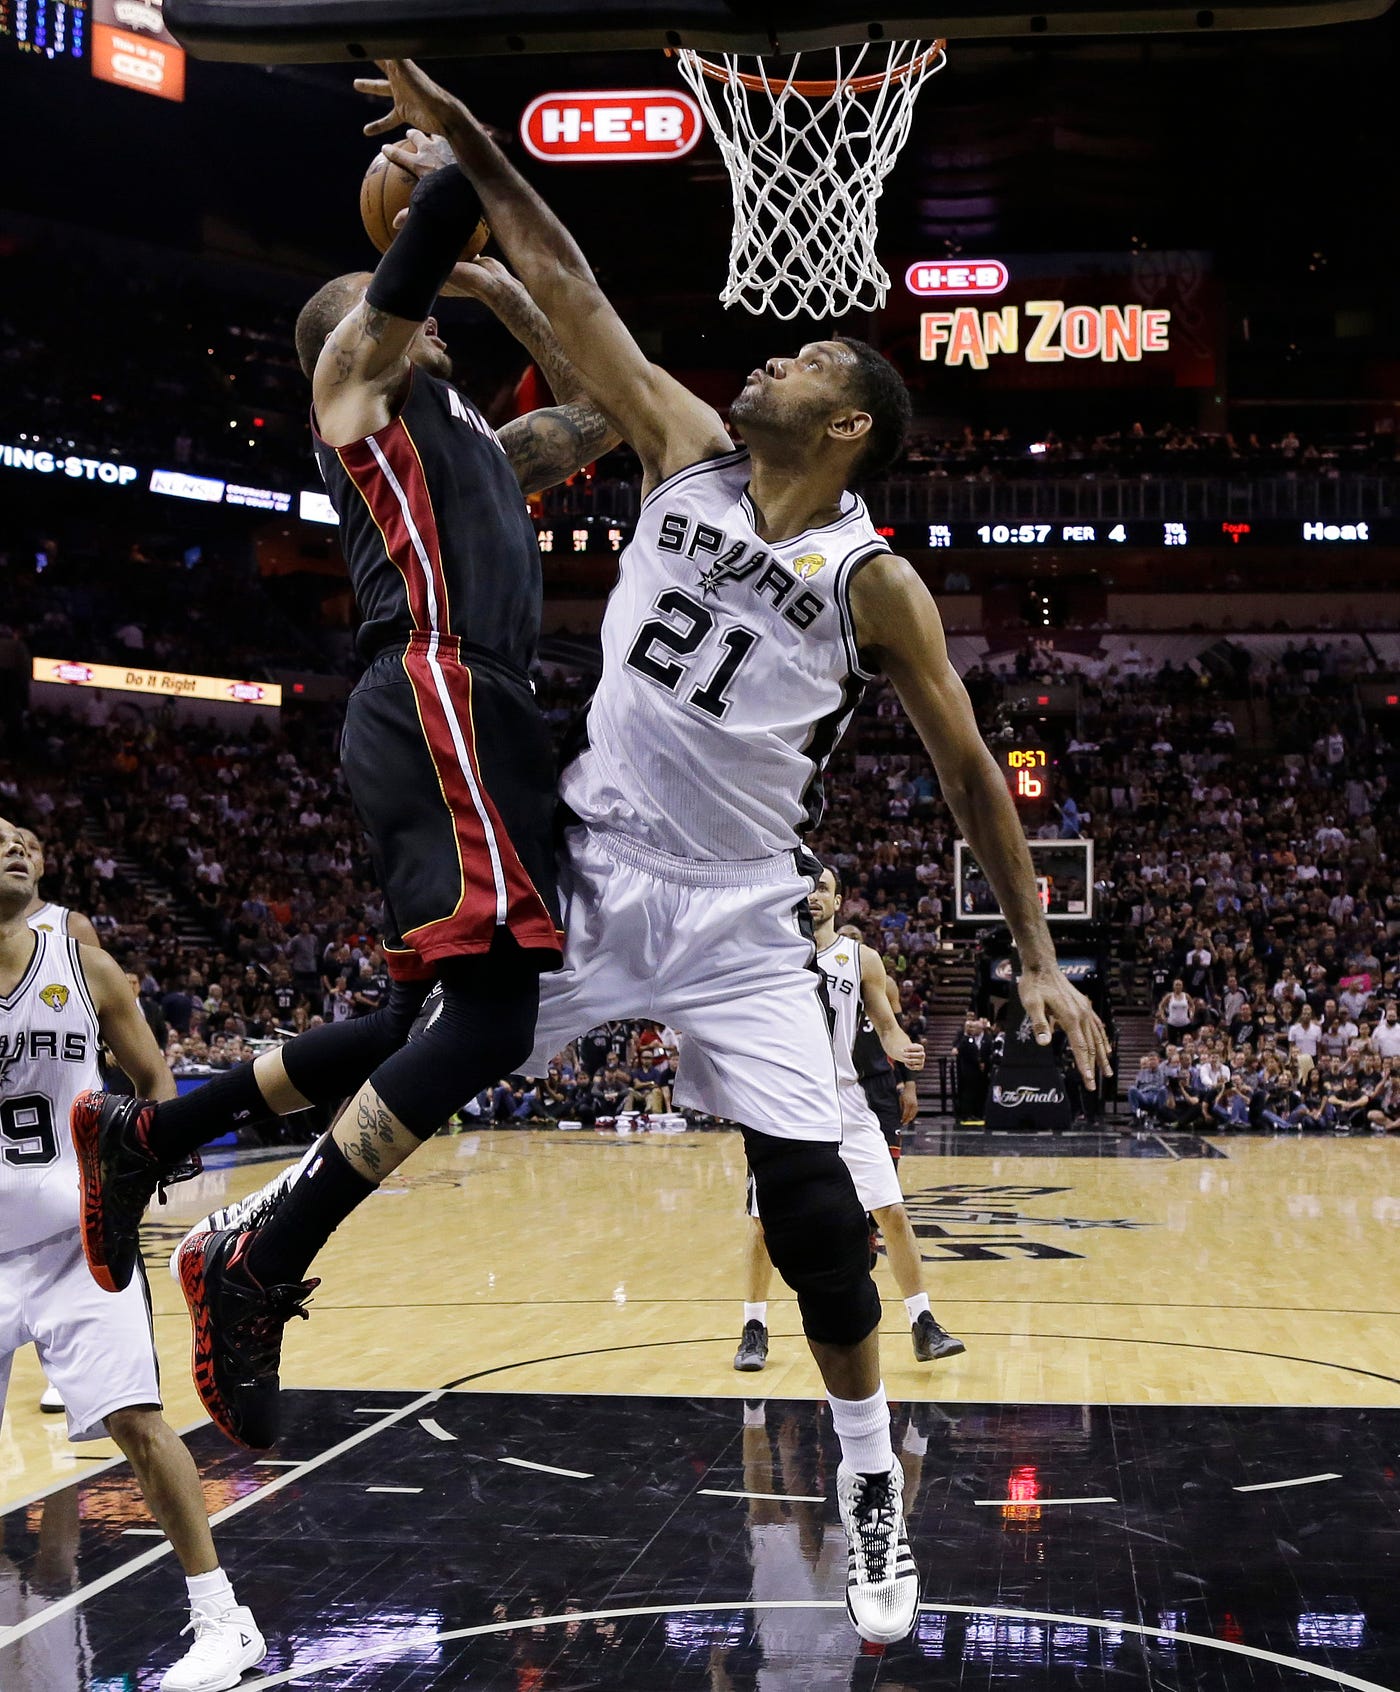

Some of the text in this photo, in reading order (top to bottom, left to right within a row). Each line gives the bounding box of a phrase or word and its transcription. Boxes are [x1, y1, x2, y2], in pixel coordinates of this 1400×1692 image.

[920, 300, 1170, 369] FAN ZONE
[977, 524, 1126, 543] 10:57 PER 4
[1303, 522, 1368, 541] Heat
[657, 512, 826, 631] SPURS
[622, 586, 761, 723] 21
[161, 676, 196, 694] Right
[1008, 750, 1046, 767] 10:57
[1011, 1086, 1064, 1107] Finals
[0, 1092, 61, 1168] 9
